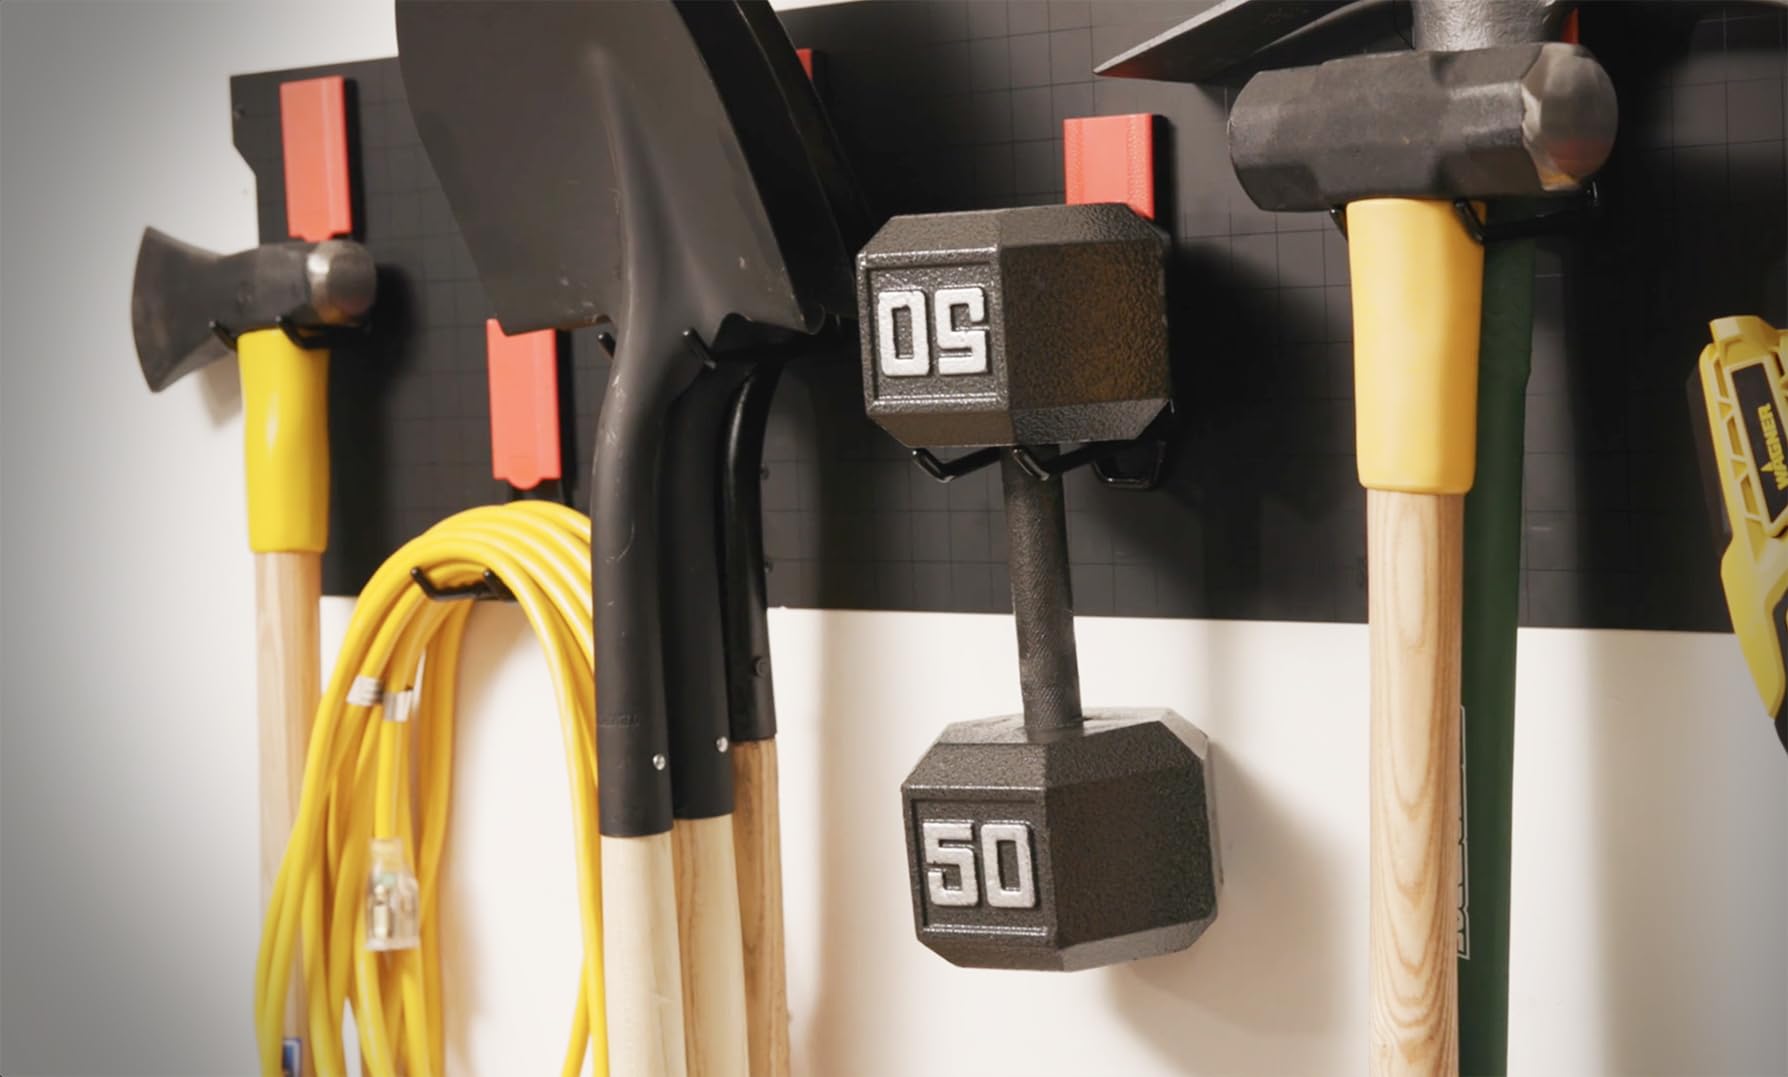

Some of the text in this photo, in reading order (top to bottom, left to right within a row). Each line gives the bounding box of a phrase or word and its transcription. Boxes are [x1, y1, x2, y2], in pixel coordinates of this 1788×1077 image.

[878, 287, 988, 376] 50
[1758, 403, 1788, 490] WAGNER
[922, 822, 1036, 908] 50
